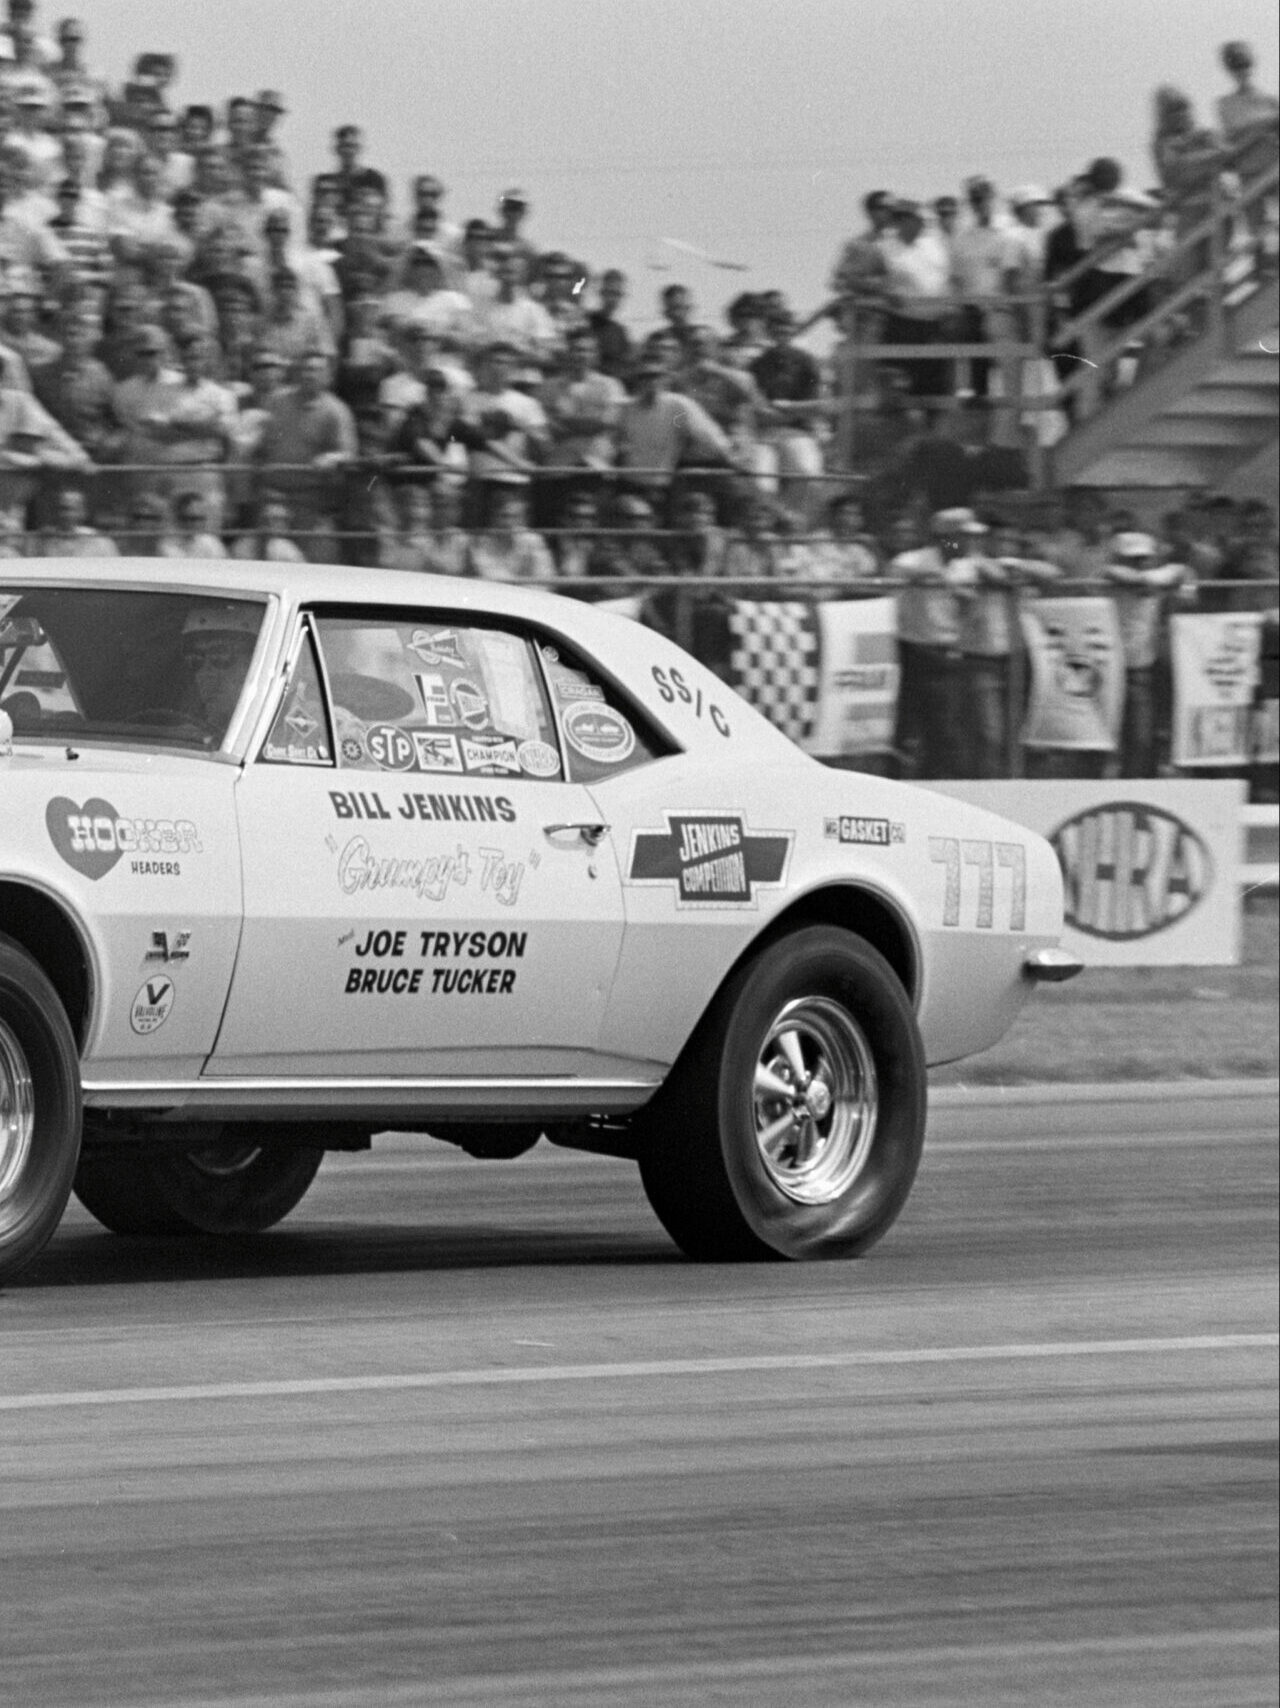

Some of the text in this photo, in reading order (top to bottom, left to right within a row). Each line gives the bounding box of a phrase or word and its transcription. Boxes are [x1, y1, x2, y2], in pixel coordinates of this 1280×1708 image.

[651, 665, 730, 738] SS/C
[371, 728, 410, 765] STP
[466, 748, 517, 763] CHAMPION
[328, 791, 517, 822] BILL JENKINS
[67, 815, 204, 853] HOOKER
[679, 823, 741, 862] JENKINS
[841, 818, 888, 842] GASKET
[131, 861, 181, 876] HEADERS
[682, 850, 747, 893] COMPETITION
[927, 836, 1026, 931] 777
[1060, 811, 1202, 935] NHRA
[355, 930, 408, 957] JOE
[420, 931, 528, 957] TRYSON
[344, 968, 517, 994] BRUCE TUCKER
